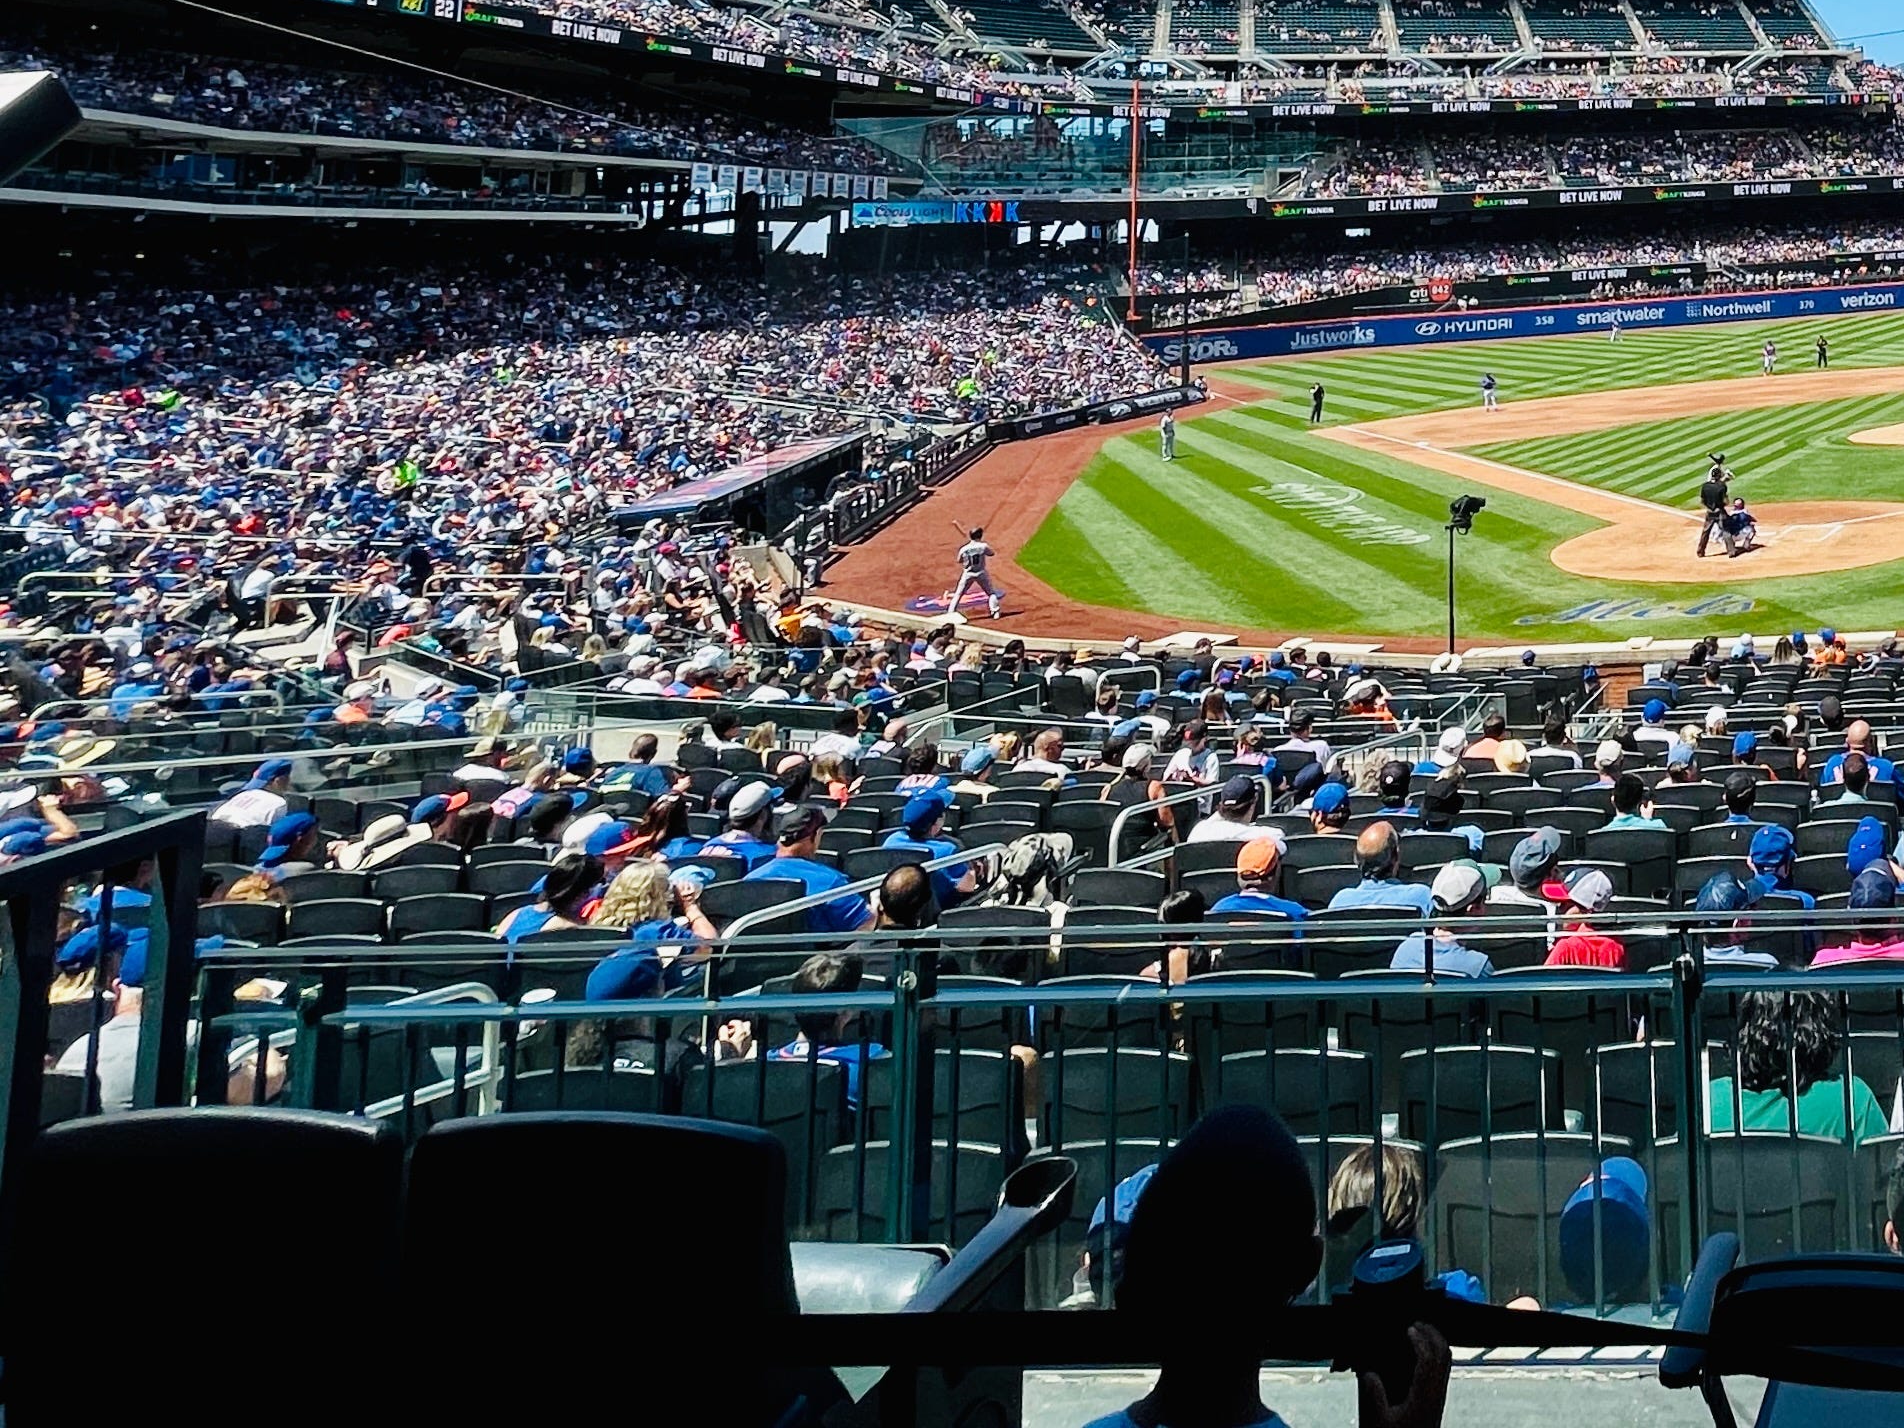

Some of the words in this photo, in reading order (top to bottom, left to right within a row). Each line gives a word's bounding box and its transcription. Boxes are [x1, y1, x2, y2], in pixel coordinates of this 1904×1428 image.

[551, 20, 572, 35] BET
[573, 24, 596, 40] LIVE
[1112, 106, 1130, 117] BET
[1150, 107, 1172, 119] NOW
[1272, 105, 1290, 116] BET
[1291, 105, 1311, 116] LIVE
[1312, 104, 1335, 115] NOW
[1559, 192, 1577, 204] BET
[1578, 191, 1599, 202] LIVE
[1600, 190, 1622, 202] NOW
[1733, 185, 1750, 196] BET
[1751, 184, 1769, 195] LIVE
[956, 202, 970, 222] K
[972, 202, 986, 222] K
[1006, 202, 1019, 222] K
[1368, 200, 1387, 212] BET
[1390, 199, 1412, 211] LIVE
[1413, 197, 1439, 210] NOW
[1572, 271, 1588, 282] BET
[1589, 270, 1606, 280] LIVE
[1841, 292, 1895, 308] verizon
[1577, 306, 1665, 325] smartwater
[1702, 300, 1771, 317] Northwell
[1444, 318, 1513, 333] HYUNDAI
[1290, 326, 1376, 348] Justworks
